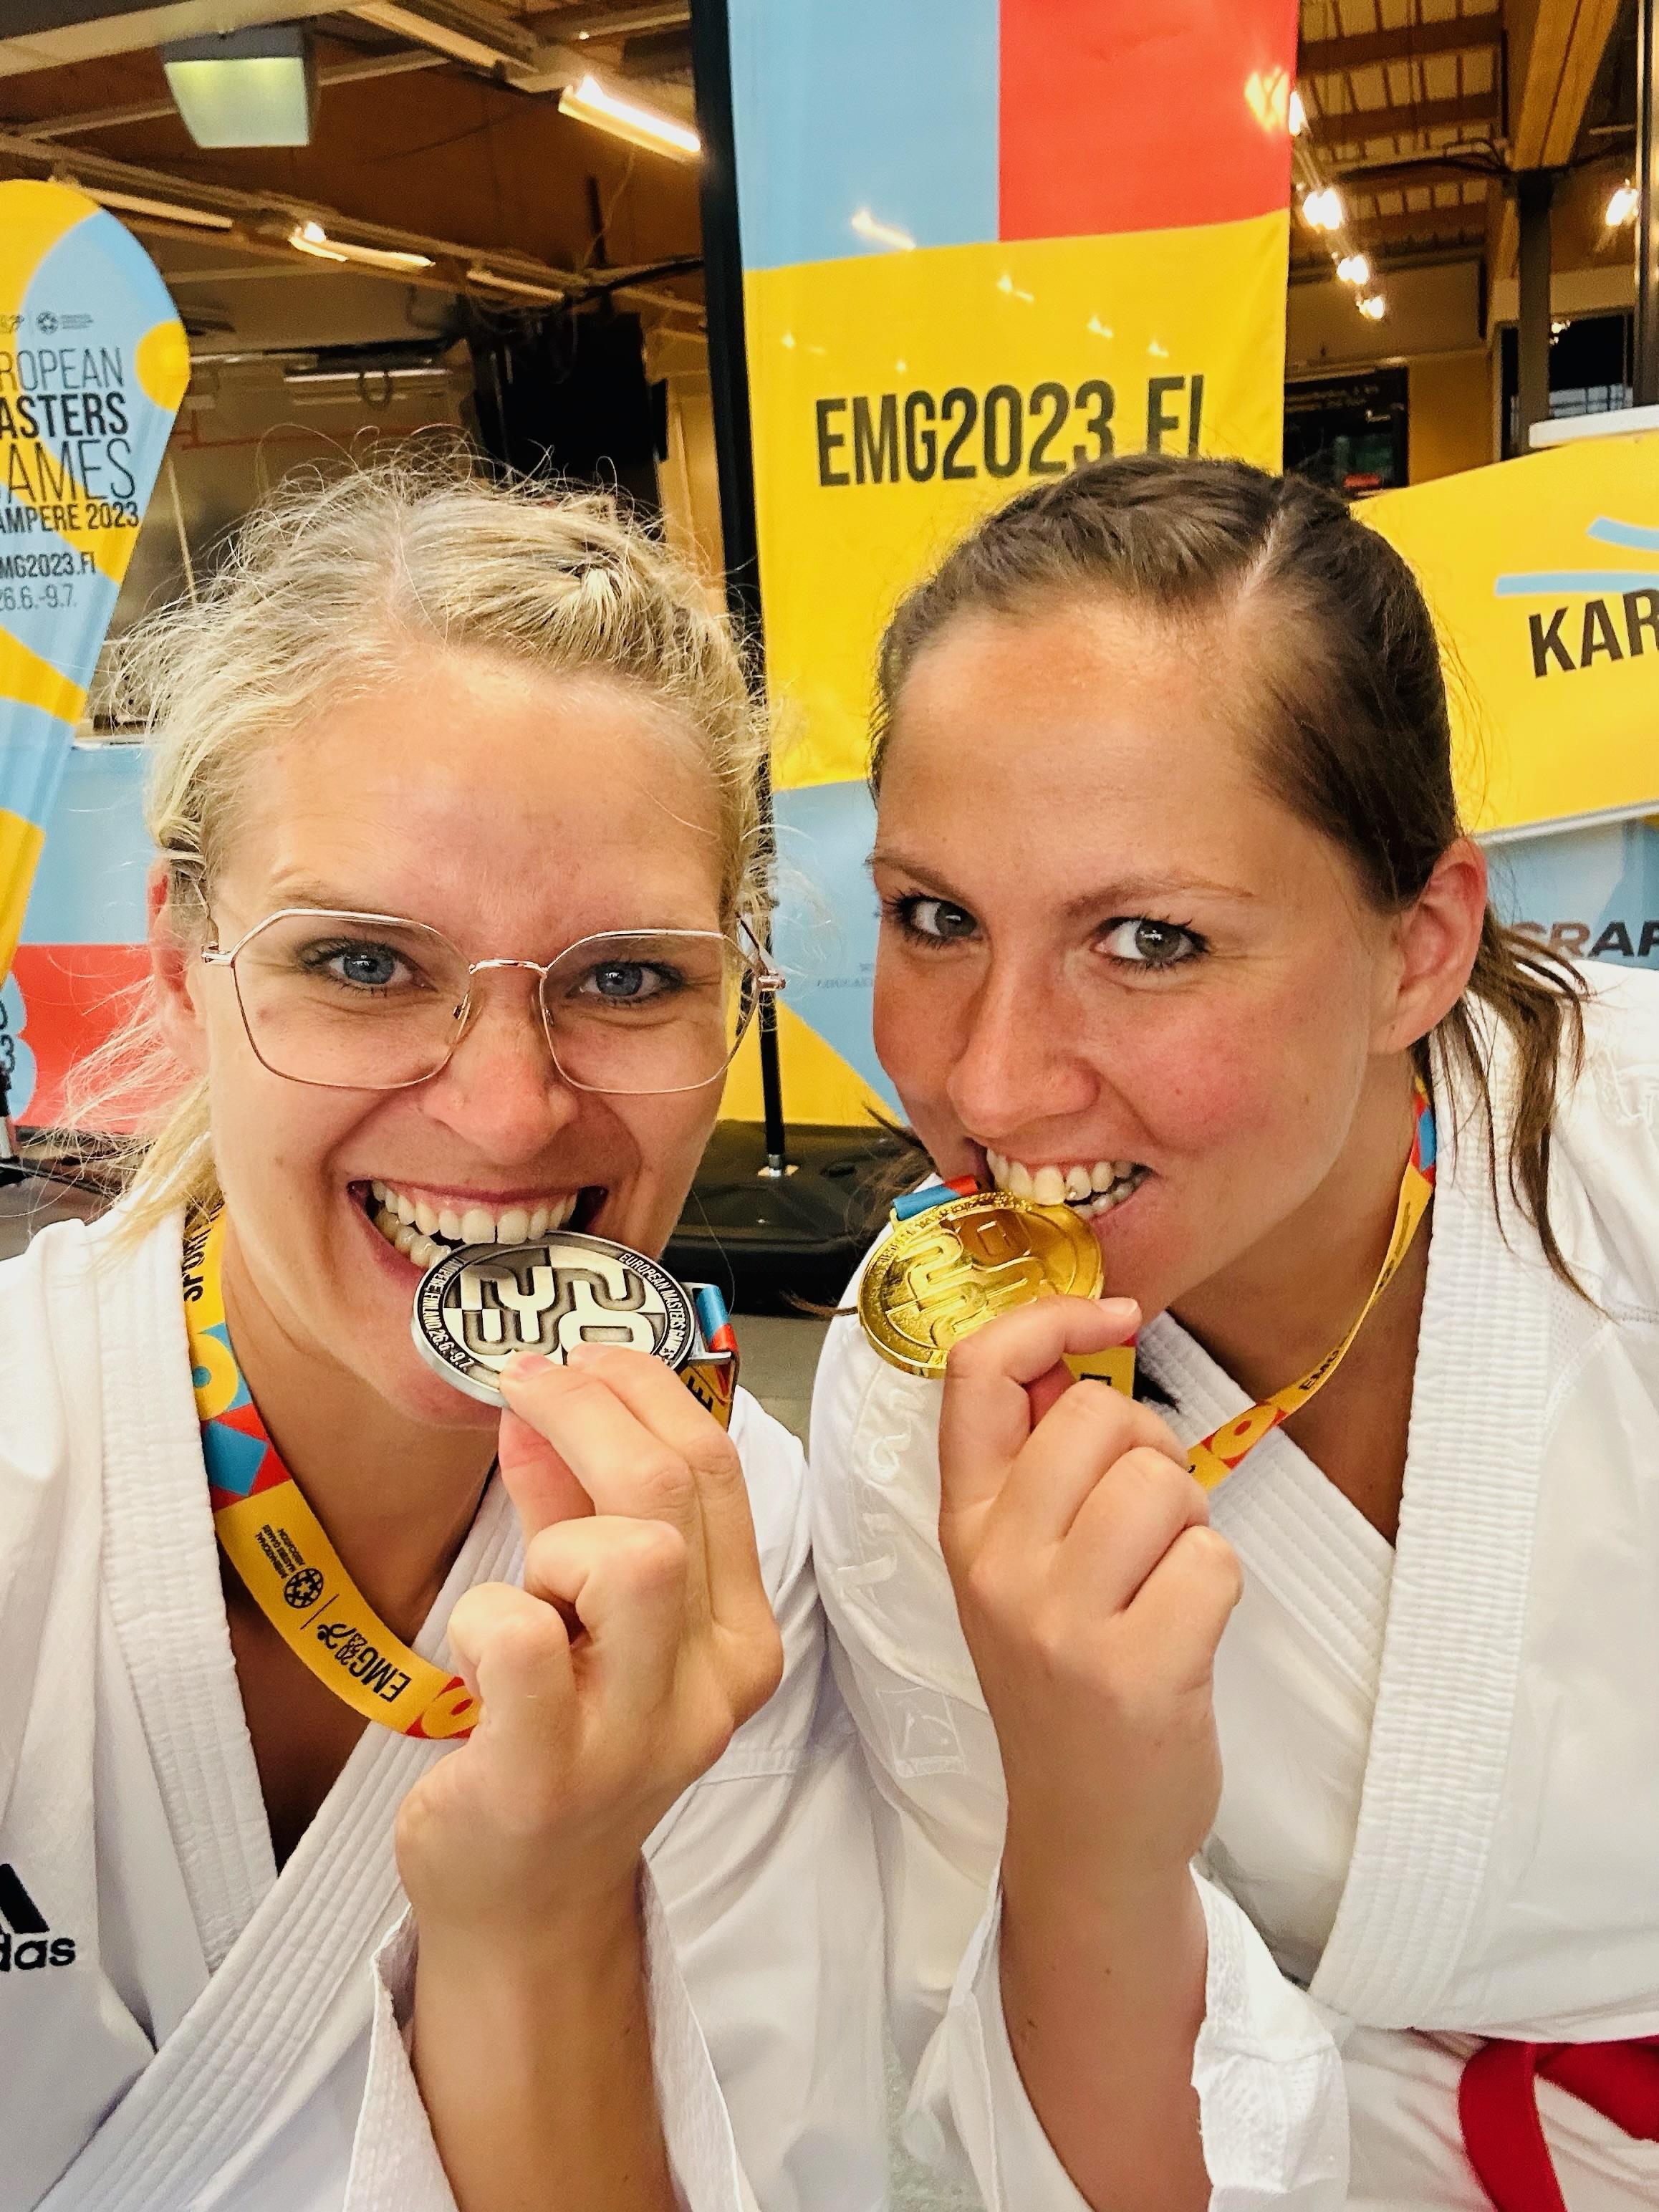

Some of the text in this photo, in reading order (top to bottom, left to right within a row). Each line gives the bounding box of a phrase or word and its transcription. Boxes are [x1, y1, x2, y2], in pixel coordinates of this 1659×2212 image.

[8, 438, 135, 504] AMES
[85, 501, 139, 529] 2023
[1528, 588, 1659, 679] KAR
[619, 1253, 671, 1294] EUROPEAN
[349, 1647, 412, 1703] EMG
